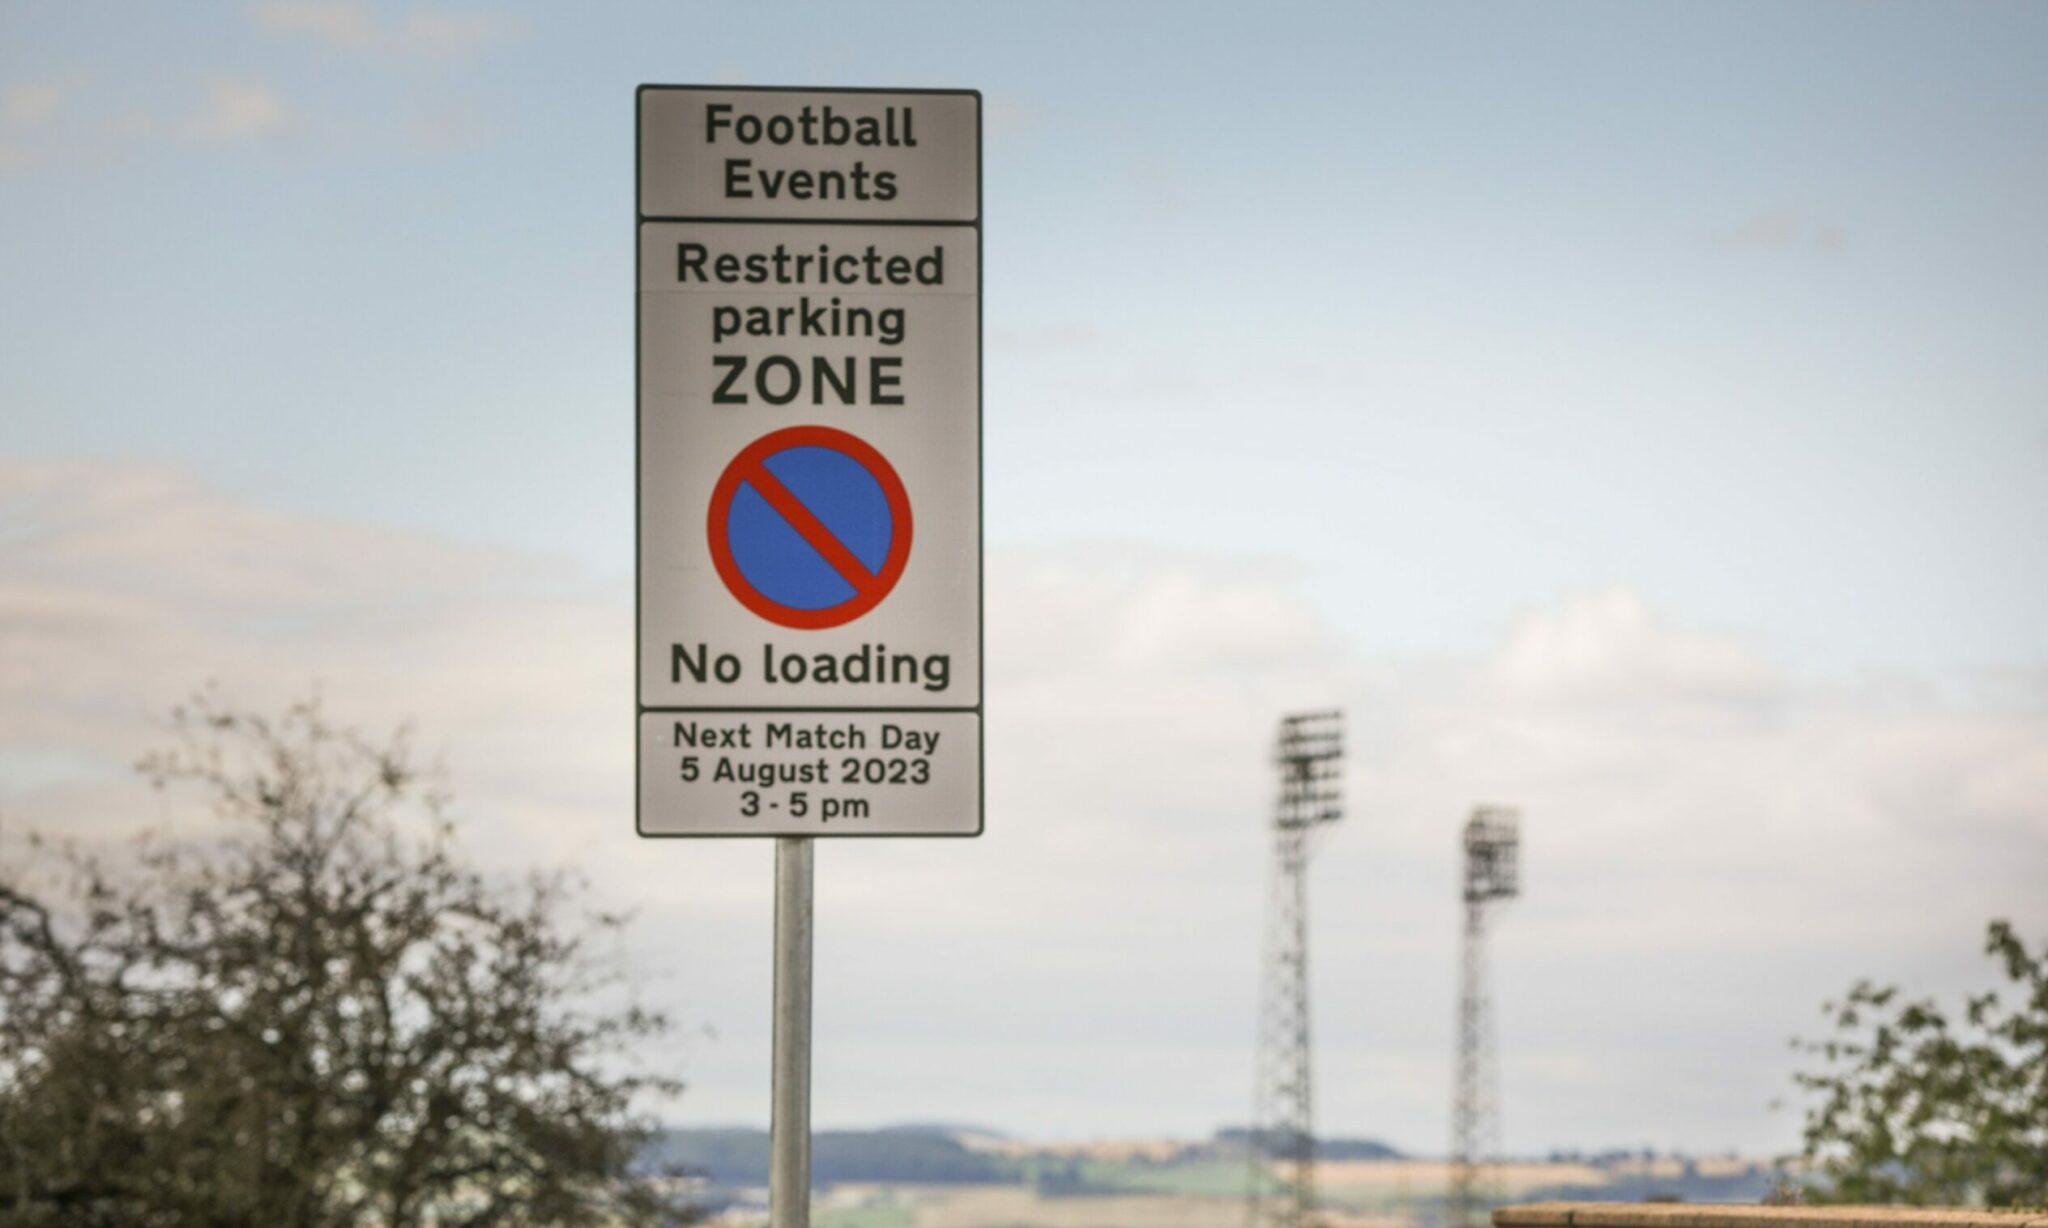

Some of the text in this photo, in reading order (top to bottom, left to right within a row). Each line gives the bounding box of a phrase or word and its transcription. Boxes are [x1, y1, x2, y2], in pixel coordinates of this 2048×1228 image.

[704, 105, 917, 148] Football
[724, 160, 899, 202] Events
[676, 241, 944, 286] Restricted
[712, 296, 905, 345] parking
[712, 354, 905, 406] ZONE
[672, 643, 949, 693] No loading
[673, 721, 940, 756] Next Match Day
[681, 757, 930, 787] 5 August 2023
[740, 791, 760, 818] 3
[789, 791, 808, 818] 5
[821, 797, 869, 823] pm
